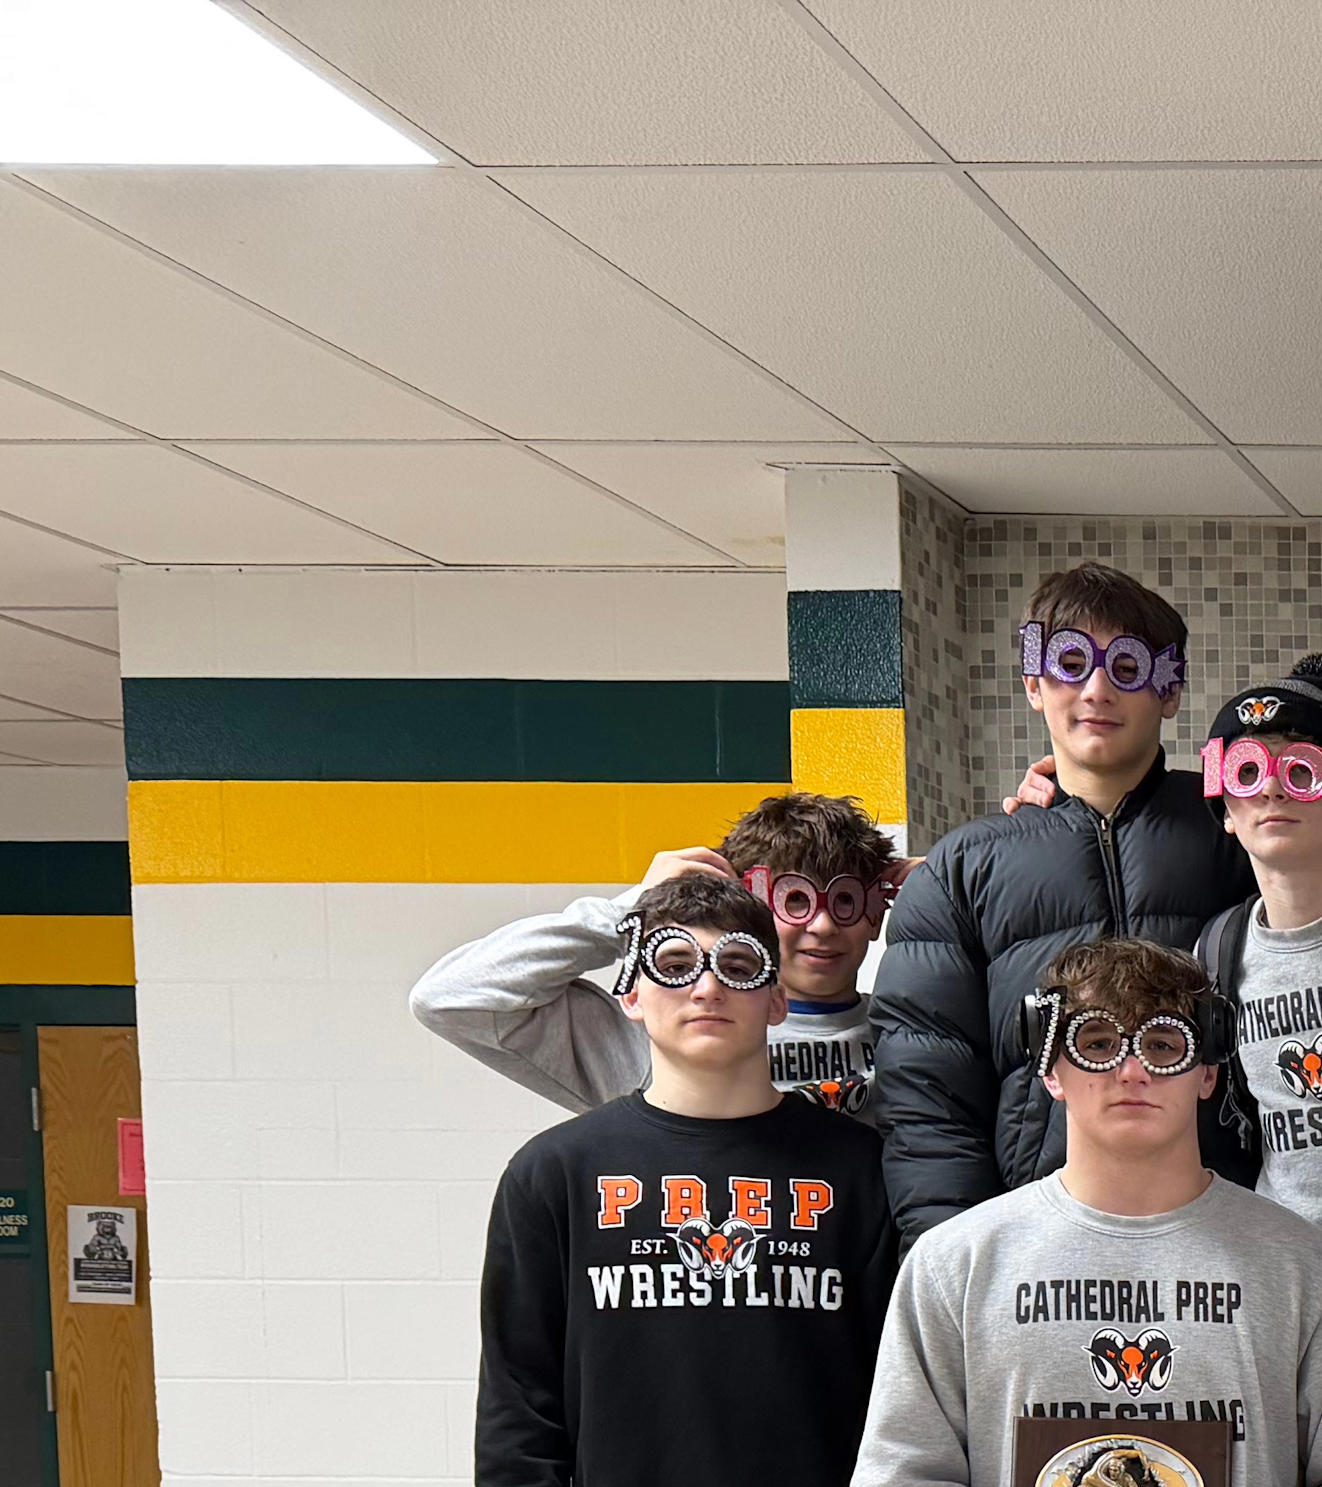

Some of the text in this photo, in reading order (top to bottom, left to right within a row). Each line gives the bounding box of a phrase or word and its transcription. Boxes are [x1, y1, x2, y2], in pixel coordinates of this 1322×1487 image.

[769, 1040, 856, 1082] HEDRAL
[597, 1174, 834, 1230] PREP
[630, 1238, 811, 1257] EST. 1948
[588, 1264, 844, 1311] WRESTLING
[1015, 1278, 1242, 1325] CATHEDRAL PREP
